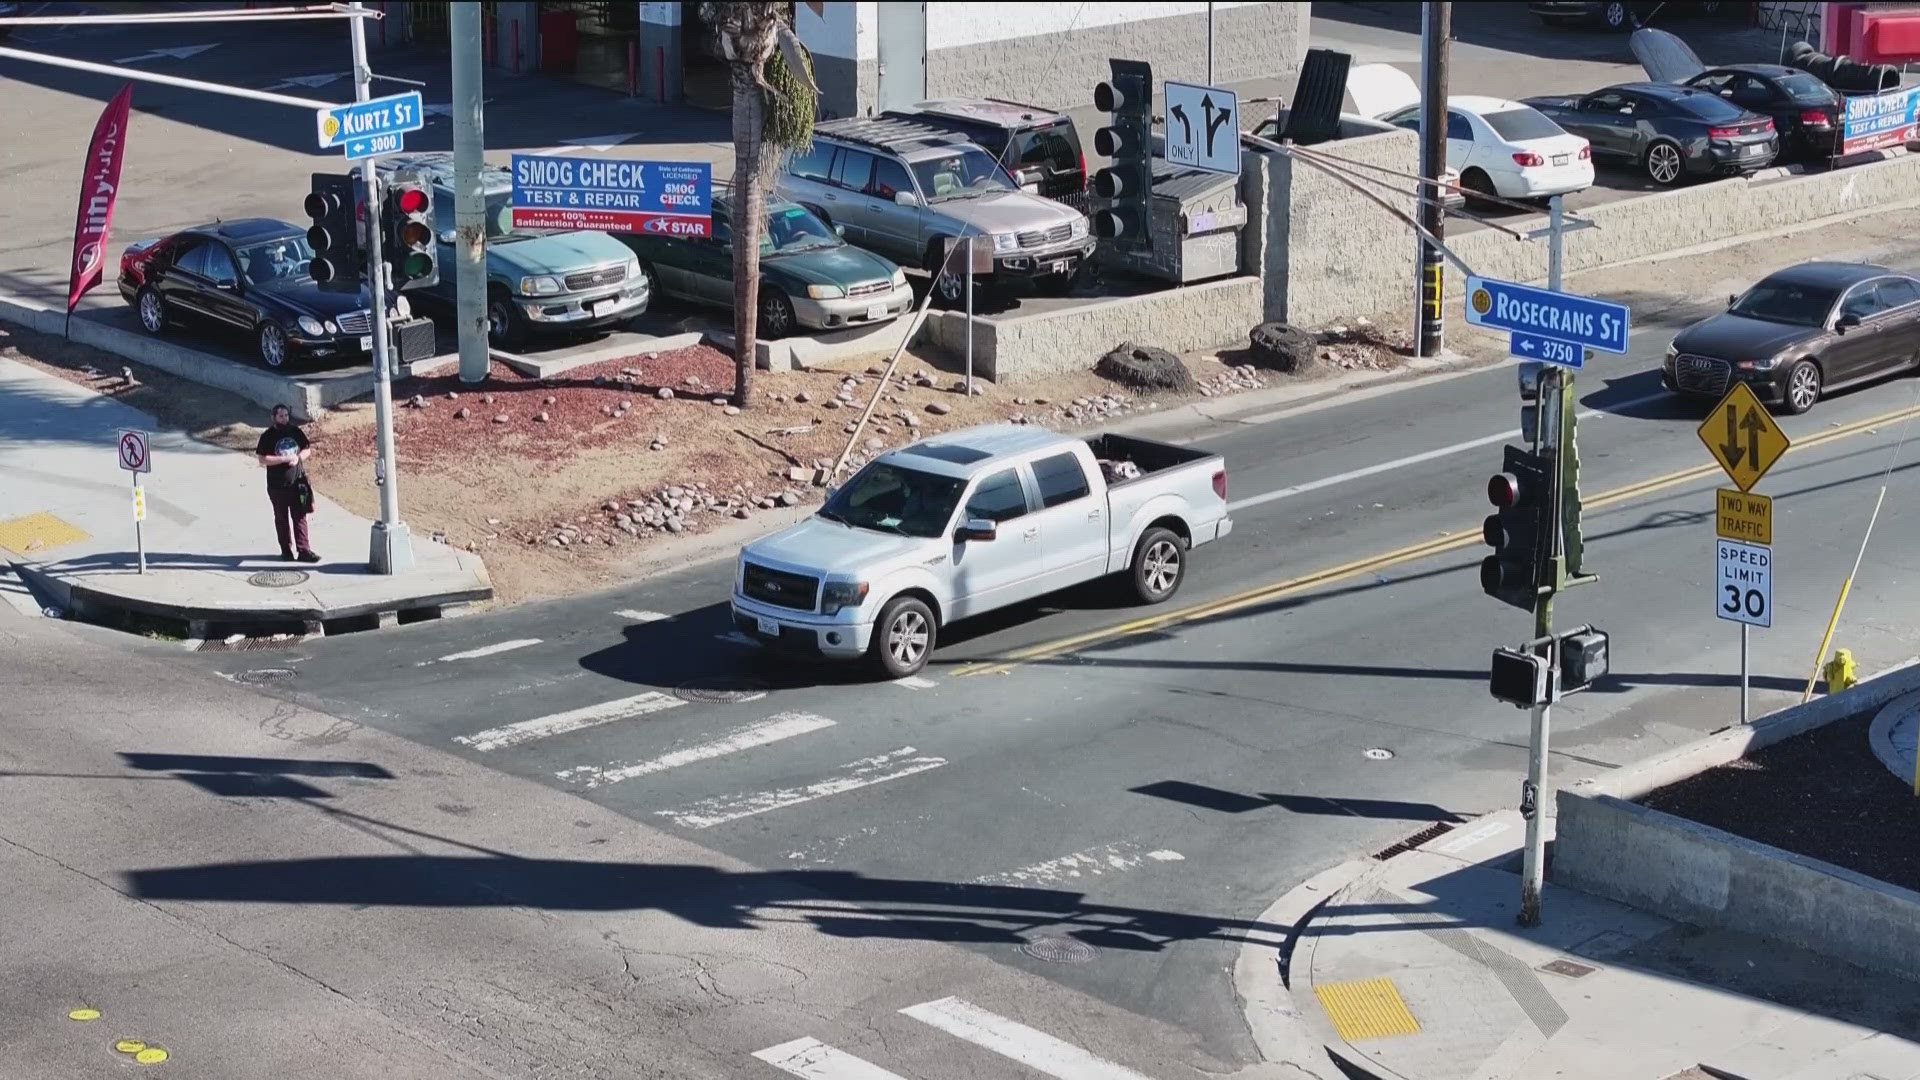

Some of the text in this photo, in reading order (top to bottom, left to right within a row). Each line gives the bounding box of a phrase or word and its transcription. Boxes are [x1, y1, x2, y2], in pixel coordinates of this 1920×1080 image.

[343, 103, 412, 134] KURTZ ST
[1850, 121, 1870, 134] TEST
[1877, 113, 1906, 128] REPAIR
[370, 135, 397, 152] 3000
[1171, 144, 1194, 160] ONLY
[517, 160, 645, 188] SMOG CHECK
[662, 172, 698, 180] LICENSED
[665, 183, 695, 194] SMOG
[524, 190, 640, 207] TEST & REPAIR
[660, 194, 701, 206] CHECK
[516, 218, 632, 231] Satisfaction Guaranteed
[561, 212, 586, 220] 100%
[671, 221, 704, 235] STAR
[1496, 291, 1621, 342] ROSECRANS ST
[1542, 341, 1574, 362] 3750
[1721, 496, 1768, 517] TWO WAY
[1721, 516, 1763, 537] TRAFFIC
[1720, 547, 1768, 567] SPEED
[1724, 566, 1763, 584] LIMIT
[1722, 584, 1765, 618] 30
